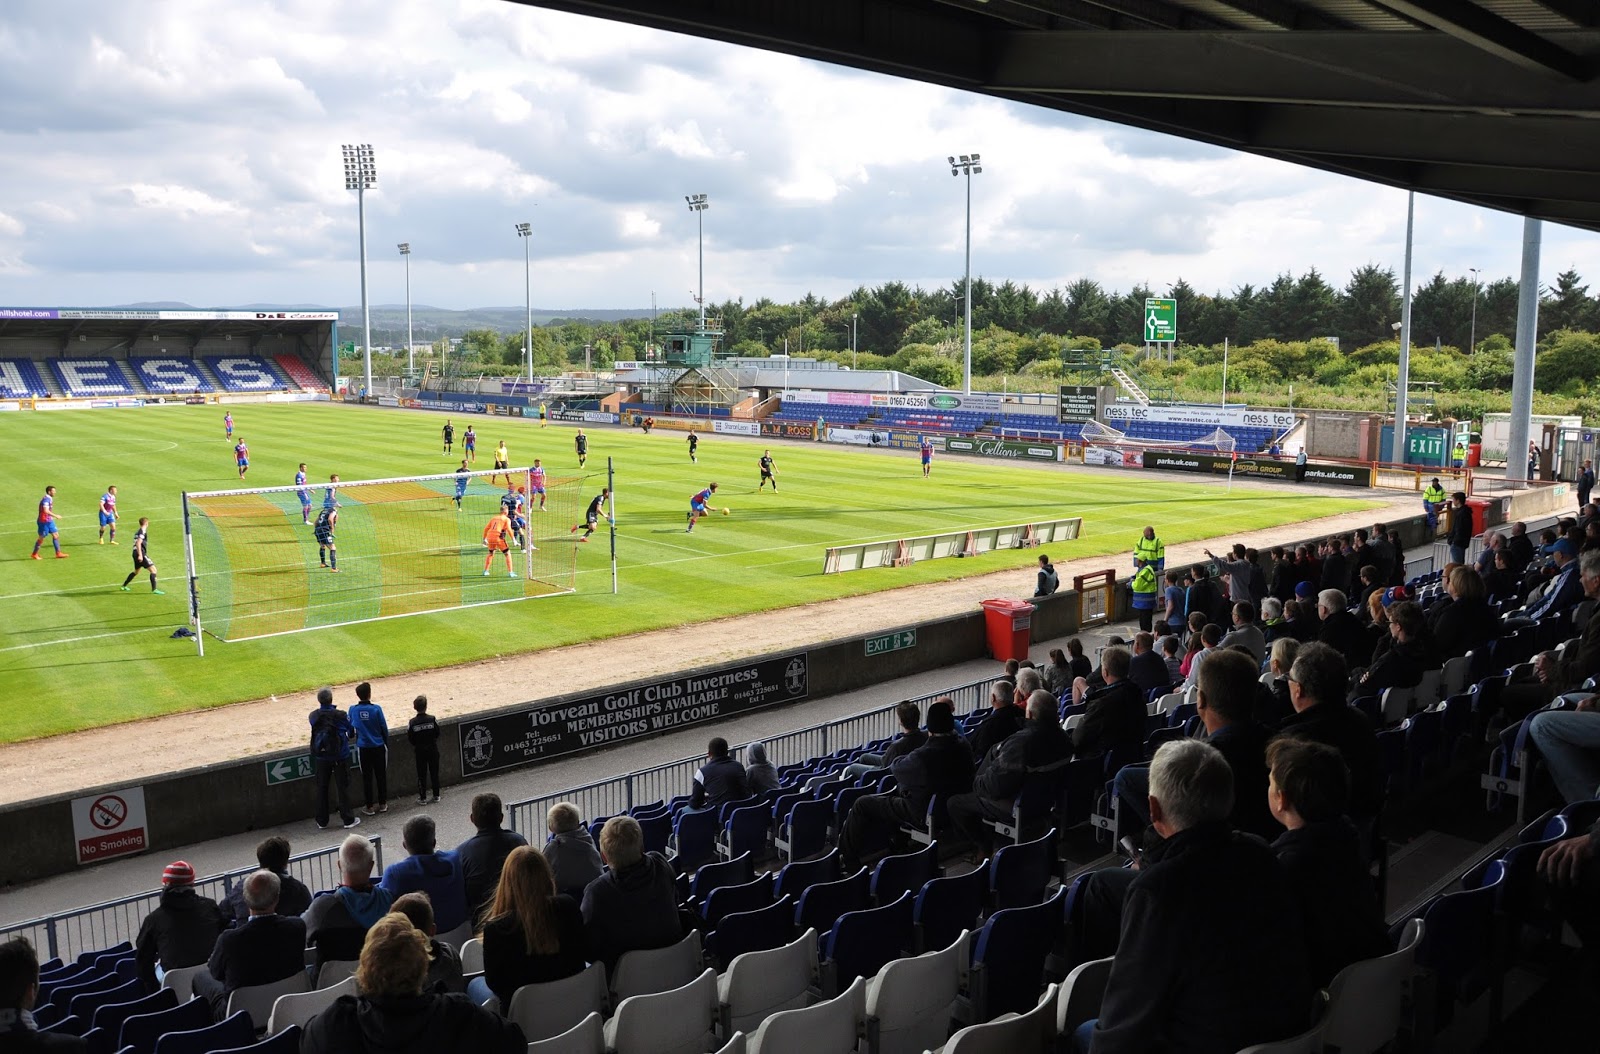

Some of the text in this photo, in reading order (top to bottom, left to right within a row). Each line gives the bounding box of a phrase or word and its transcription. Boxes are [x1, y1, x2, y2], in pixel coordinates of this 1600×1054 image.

[890, 396, 927, 406] 01667 452561
[1106, 407, 1148, 417] ness tec
[1243, 414, 1292, 425] ness tec
[762, 425, 770, 434] A.
[773, 426, 783, 434] M.
[787, 426, 811, 436] ROSS
[892, 433, 918, 442] INVERNESS
[979, 441, 1020, 458] Gellions
[1410, 439, 1442, 454] EXIT
[1157, 458, 1199, 467] parks.uk.com
[1304, 470, 1354, 480] parks.uk.com
[318, 513, 325, 523] 5
[867, 637, 889, 653] EXIT
[751, 681, 763, 689] Tel:
[528, 702, 600, 727] Torvean
[604, 689, 641, 711] Golf
[644, 683, 682, 702] Club
[687, 668, 759, 694] Inverness
[734, 684, 779, 700] 01463 225651
[567, 688, 729, 733] MEMBERSHIPS AVAILABLE
[579, 703, 720, 746] VISITORS WELCOME
[525, 730, 540, 740] Tel:
[504, 734, 562, 753] 01463 225651
[524, 748, 537, 756] Ext
[82, 836, 142, 855] No Smoking
